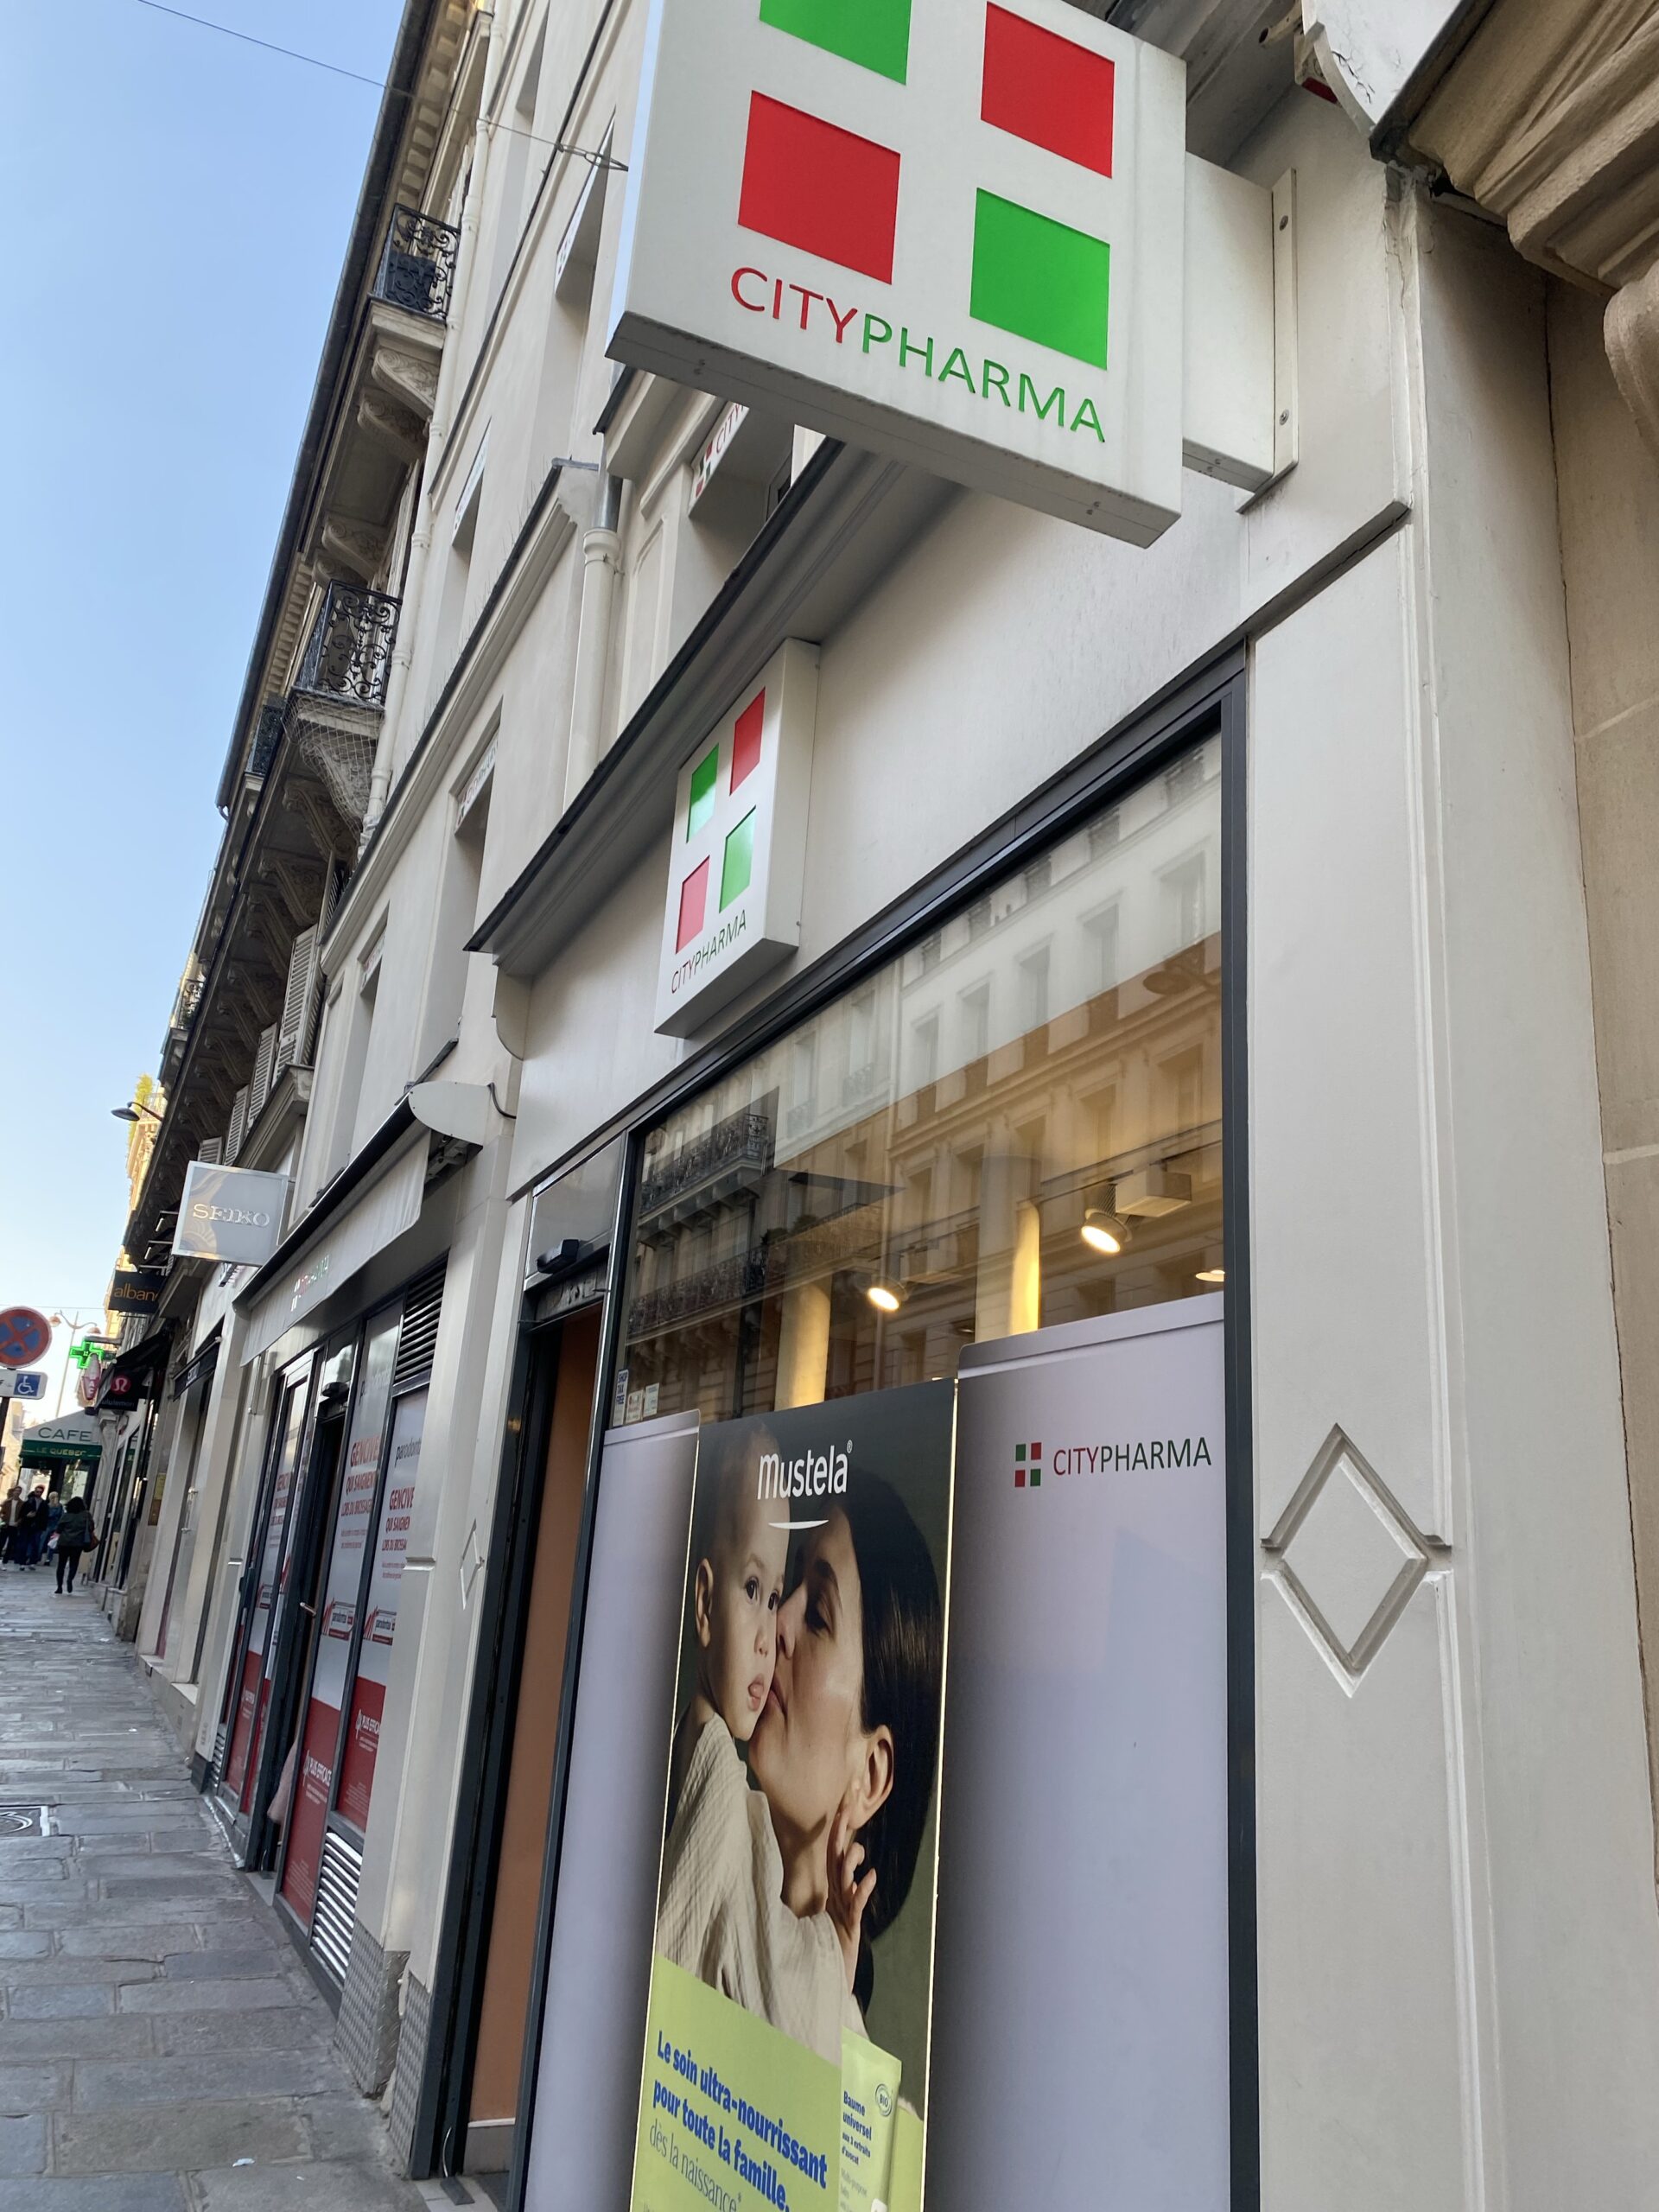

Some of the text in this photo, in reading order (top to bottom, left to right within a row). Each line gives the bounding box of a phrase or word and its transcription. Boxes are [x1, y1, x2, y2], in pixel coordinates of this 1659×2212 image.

[730, 266, 1105, 443] CITYPHARMA
[671, 909, 747, 995] CITYPHARMA
[193, 1204, 270, 1227] SEIKO
[113, 1282, 159, 1301] alban
[618, 1370, 628, 1382] SHOP
[1053, 1437, 1211, 1476] CITYPHARMA
[657, 2030, 828, 2190] Le soin ultra-nourrissant
[843, 2090, 866, 2117] Baume
[879, 2094, 888, 2107] BIO
[652, 2079, 680, 2119] pour
[682, 2098, 715, 2151] toute
[718, 2125, 731, 2165] la
[842, 2111, 872, 2141] universel
[650, 2118, 668, 2158] dès
[670, 2133, 679, 2170] la
